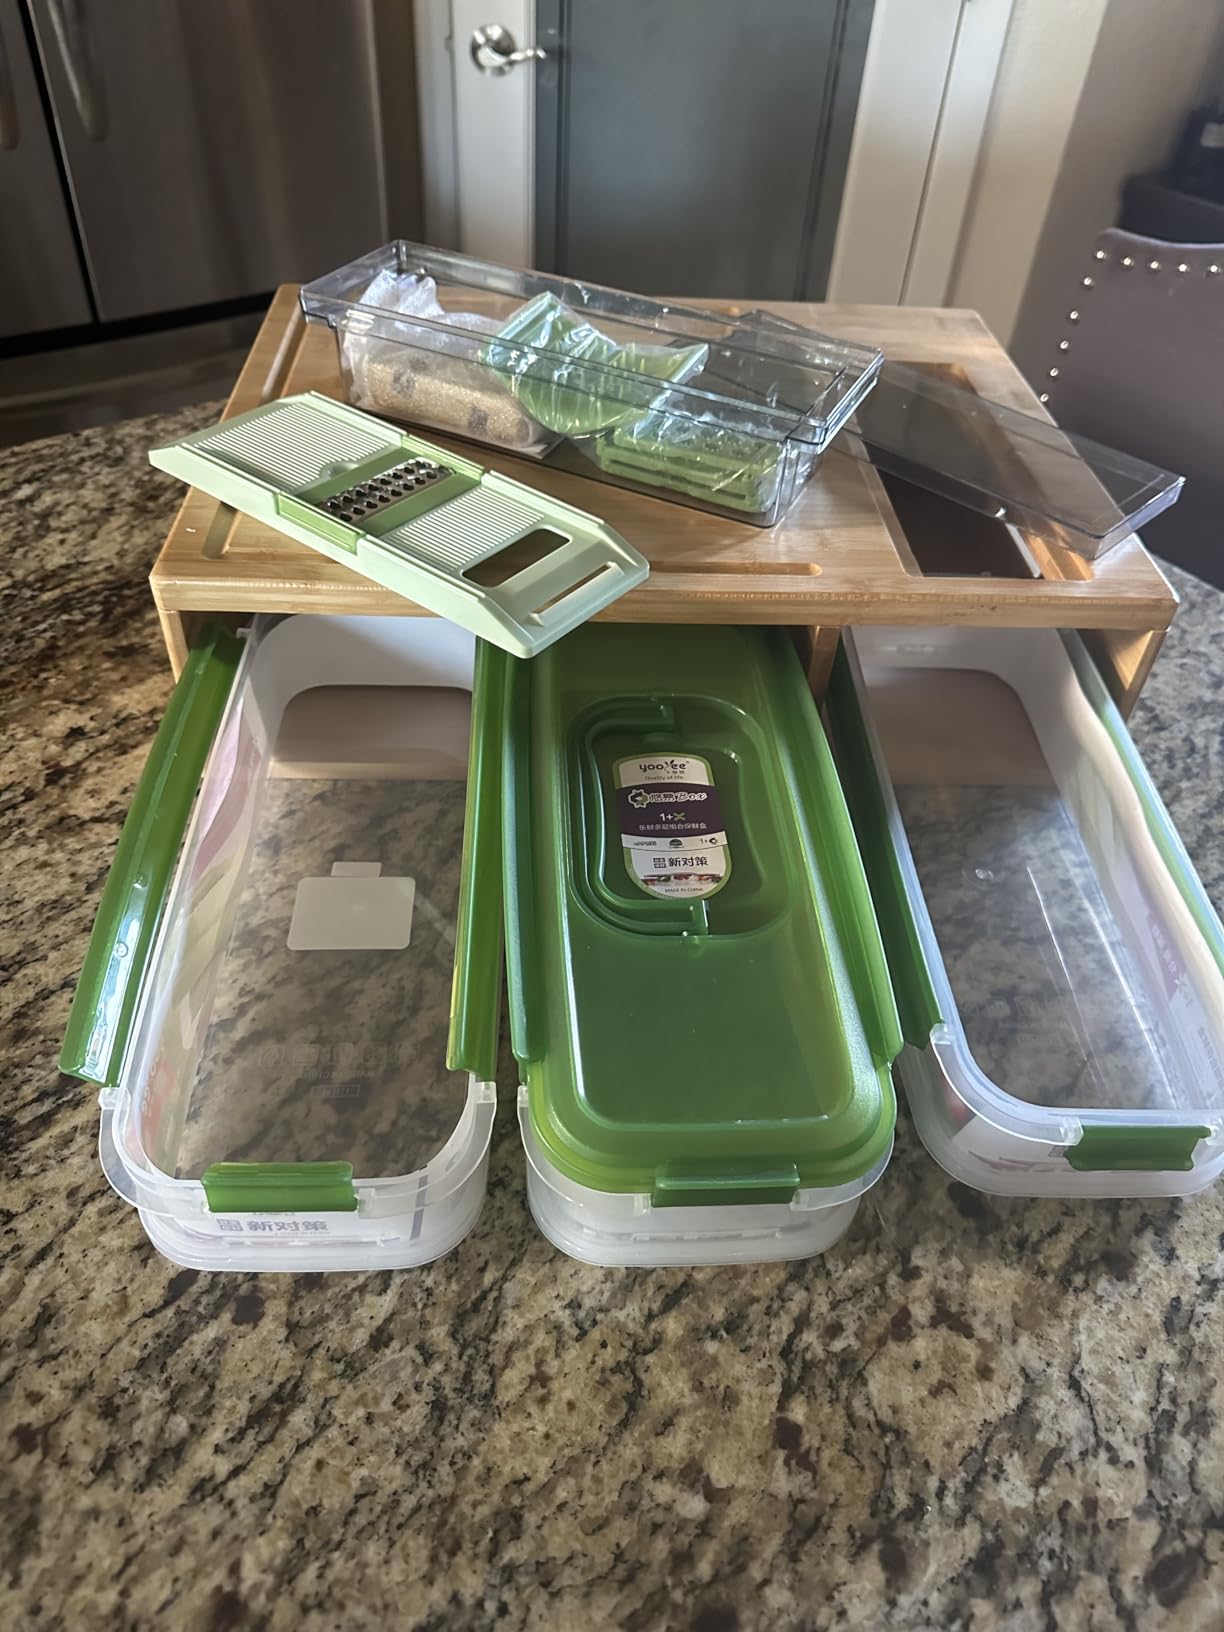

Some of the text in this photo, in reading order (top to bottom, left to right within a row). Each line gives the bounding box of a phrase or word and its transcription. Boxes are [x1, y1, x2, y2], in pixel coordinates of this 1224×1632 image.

[667, 856, 709, 867] 新对策
[246, 1220, 329, 1232] 新对策
